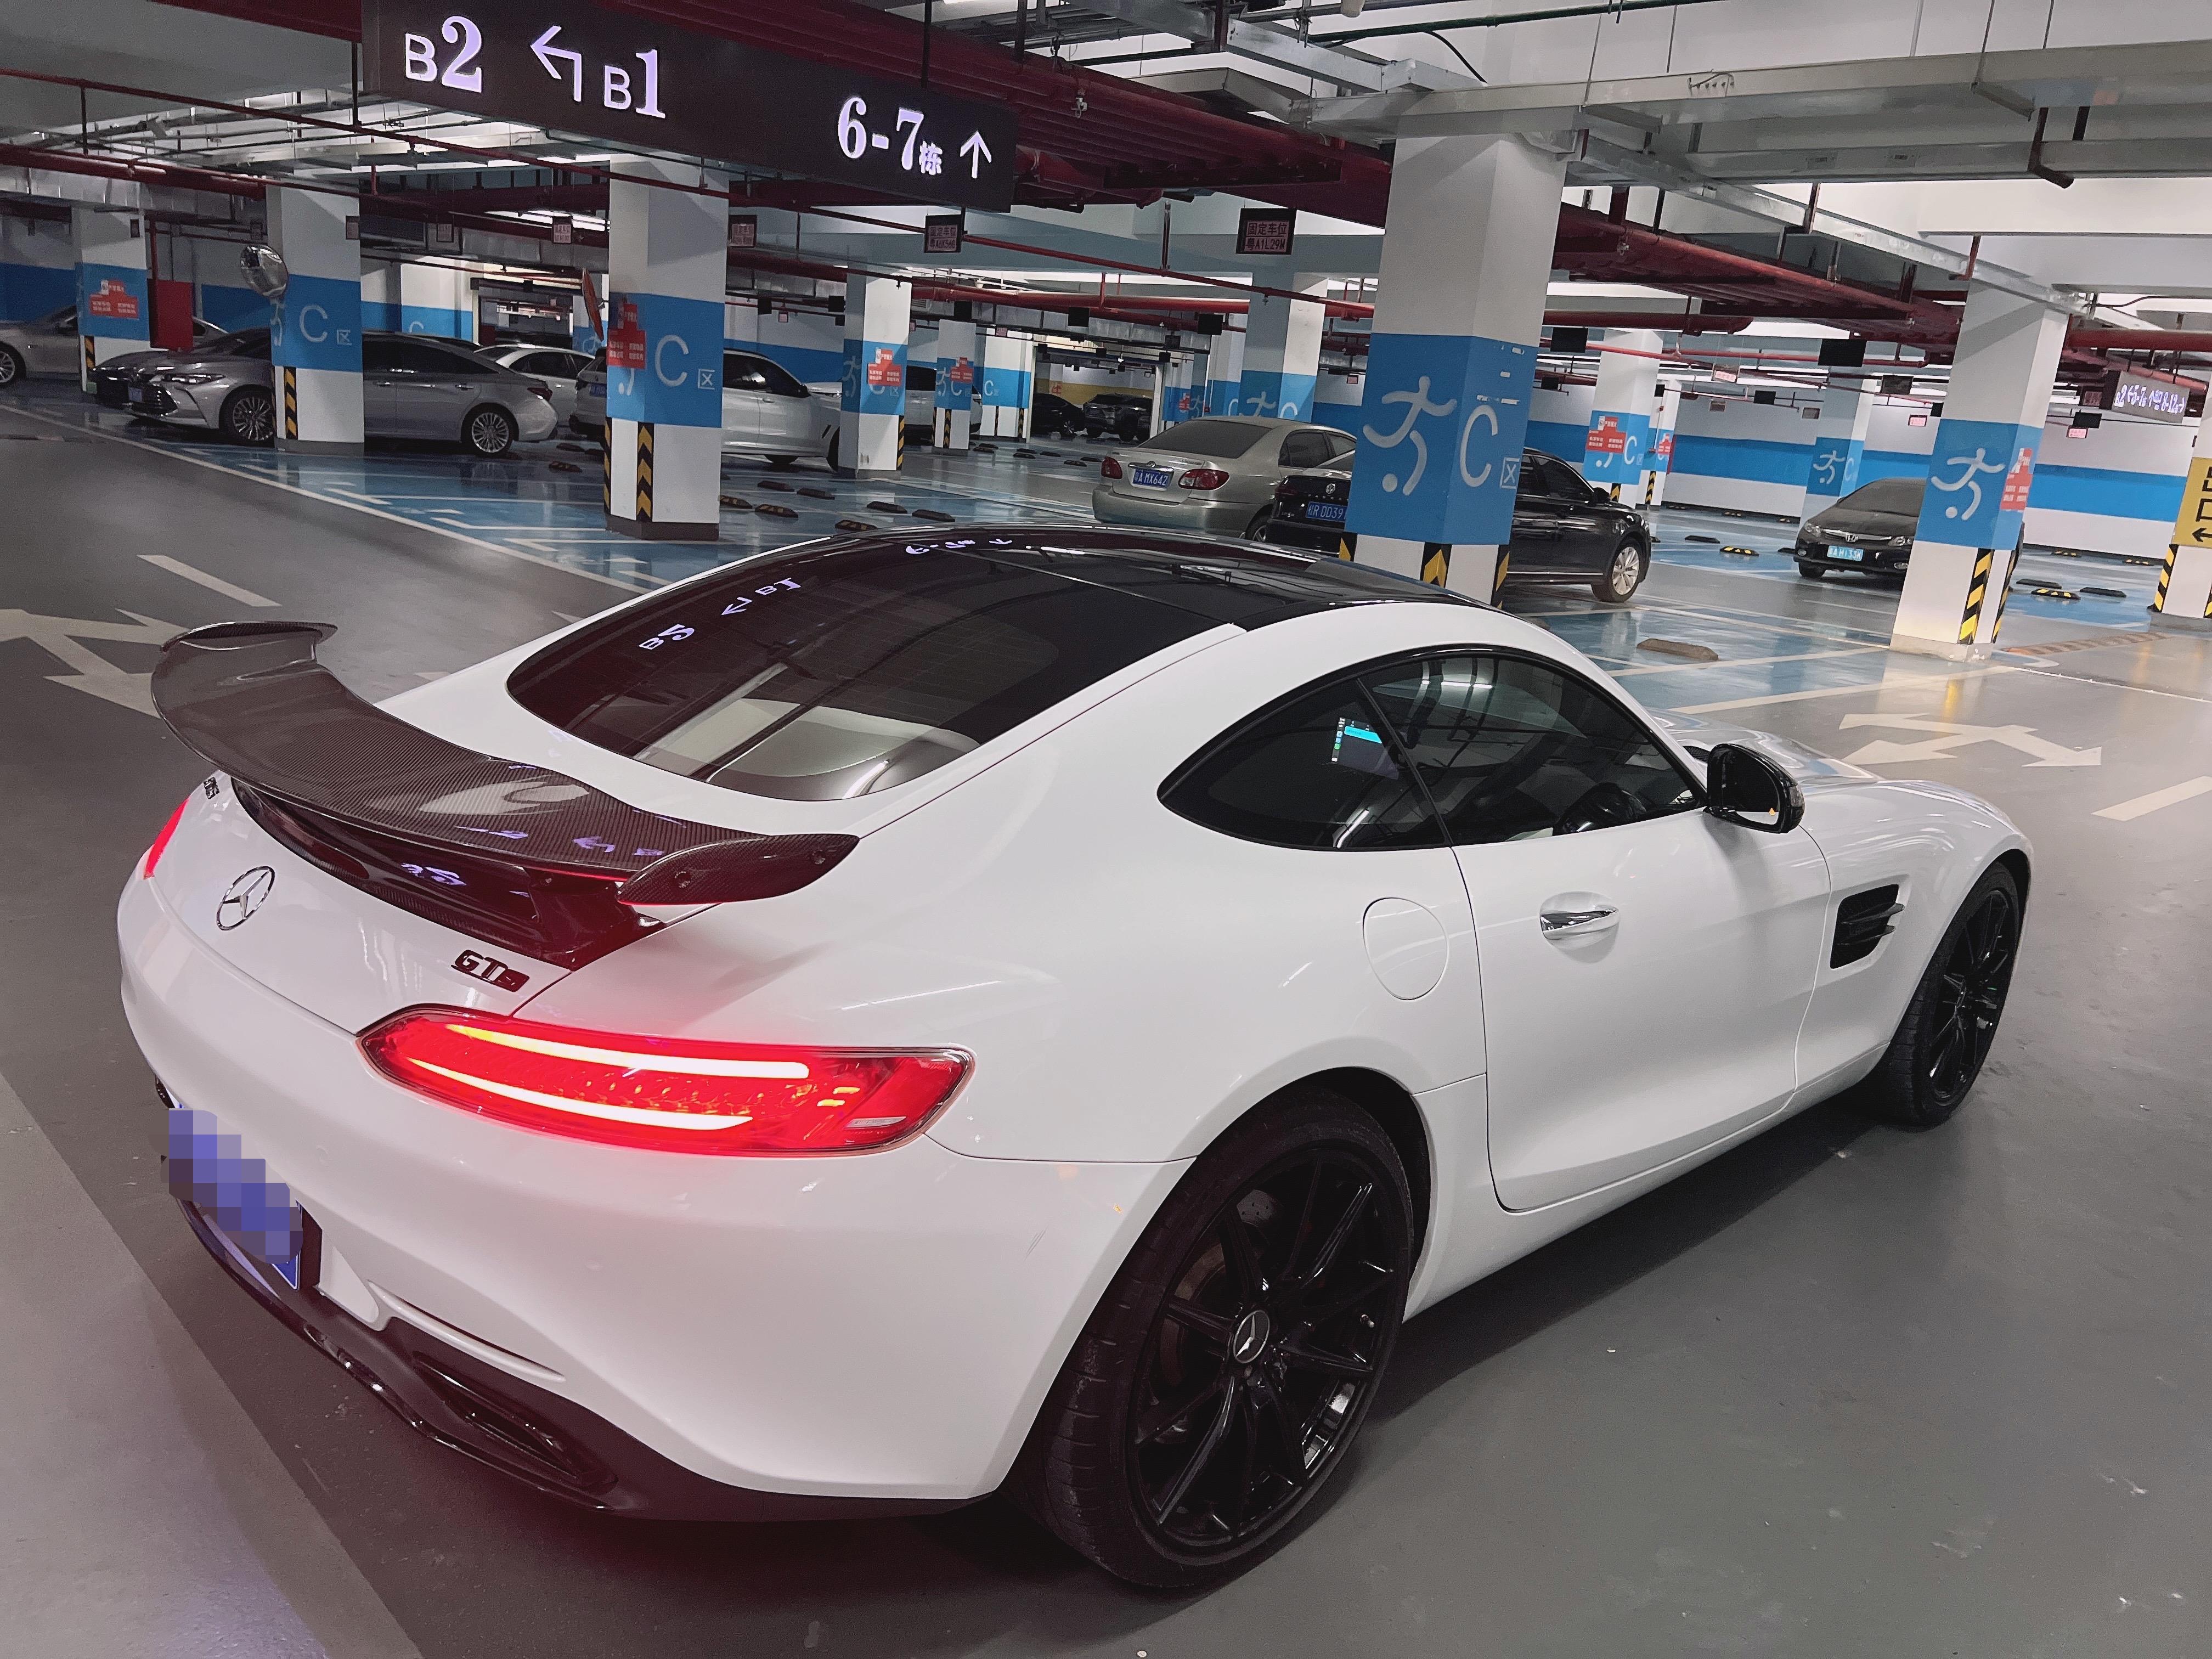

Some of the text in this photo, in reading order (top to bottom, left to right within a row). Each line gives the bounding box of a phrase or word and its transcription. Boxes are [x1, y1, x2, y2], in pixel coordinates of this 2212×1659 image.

[405, 15, 665, 119] B2 B1
[838, 96, 943, 175] 6-7栋
[1247, 222, 1288, 235] 固定车位
[1307, 504, 1347, 520] RDD39
